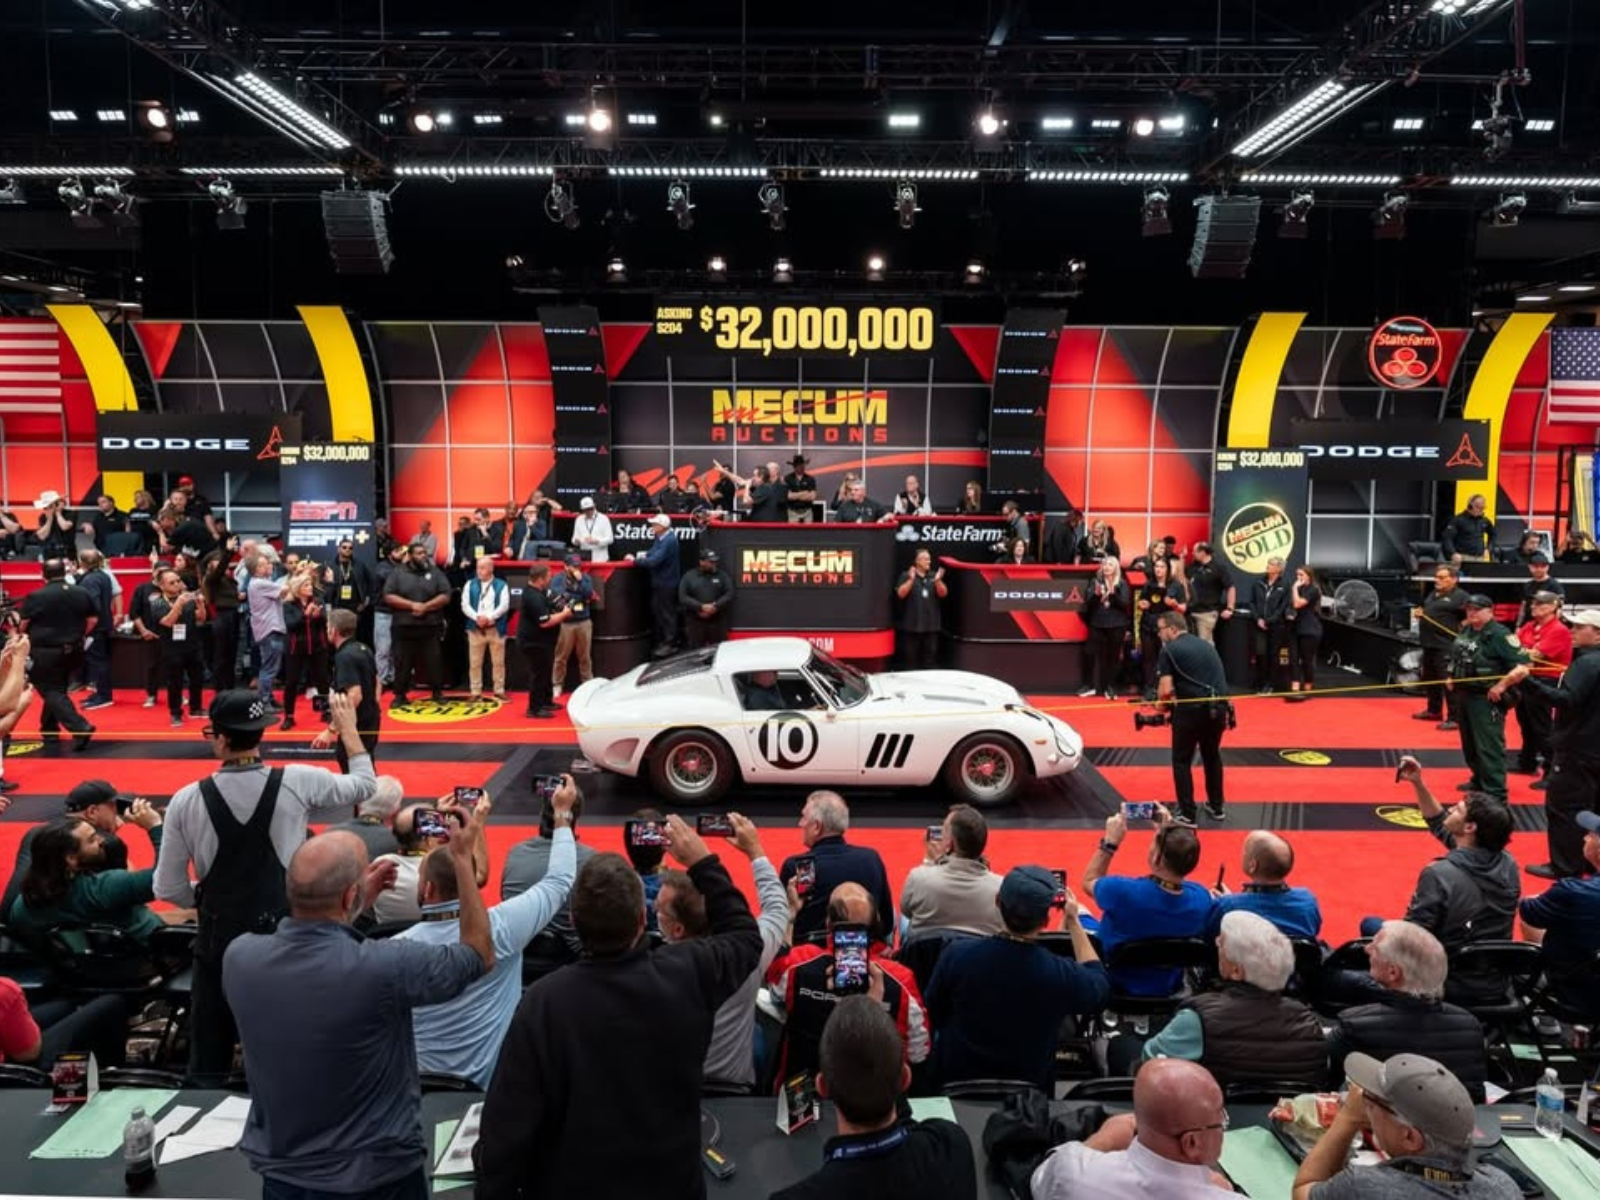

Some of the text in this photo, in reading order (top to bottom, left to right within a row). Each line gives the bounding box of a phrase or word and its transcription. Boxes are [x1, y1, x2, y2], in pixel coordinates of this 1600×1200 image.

[657, 305, 934, 357] ASKING $32,000,000
[712, 390, 888, 424] MECUM
[102, 437, 250, 450] DODGE
[711, 427, 888, 442] AUCTIONS
[1232, 528, 1292, 564] SOLD
[743, 550, 853, 572] MECUM
[742, 573, 854, 583] AUCTIONS
[767, 718, 814, 763] 10
